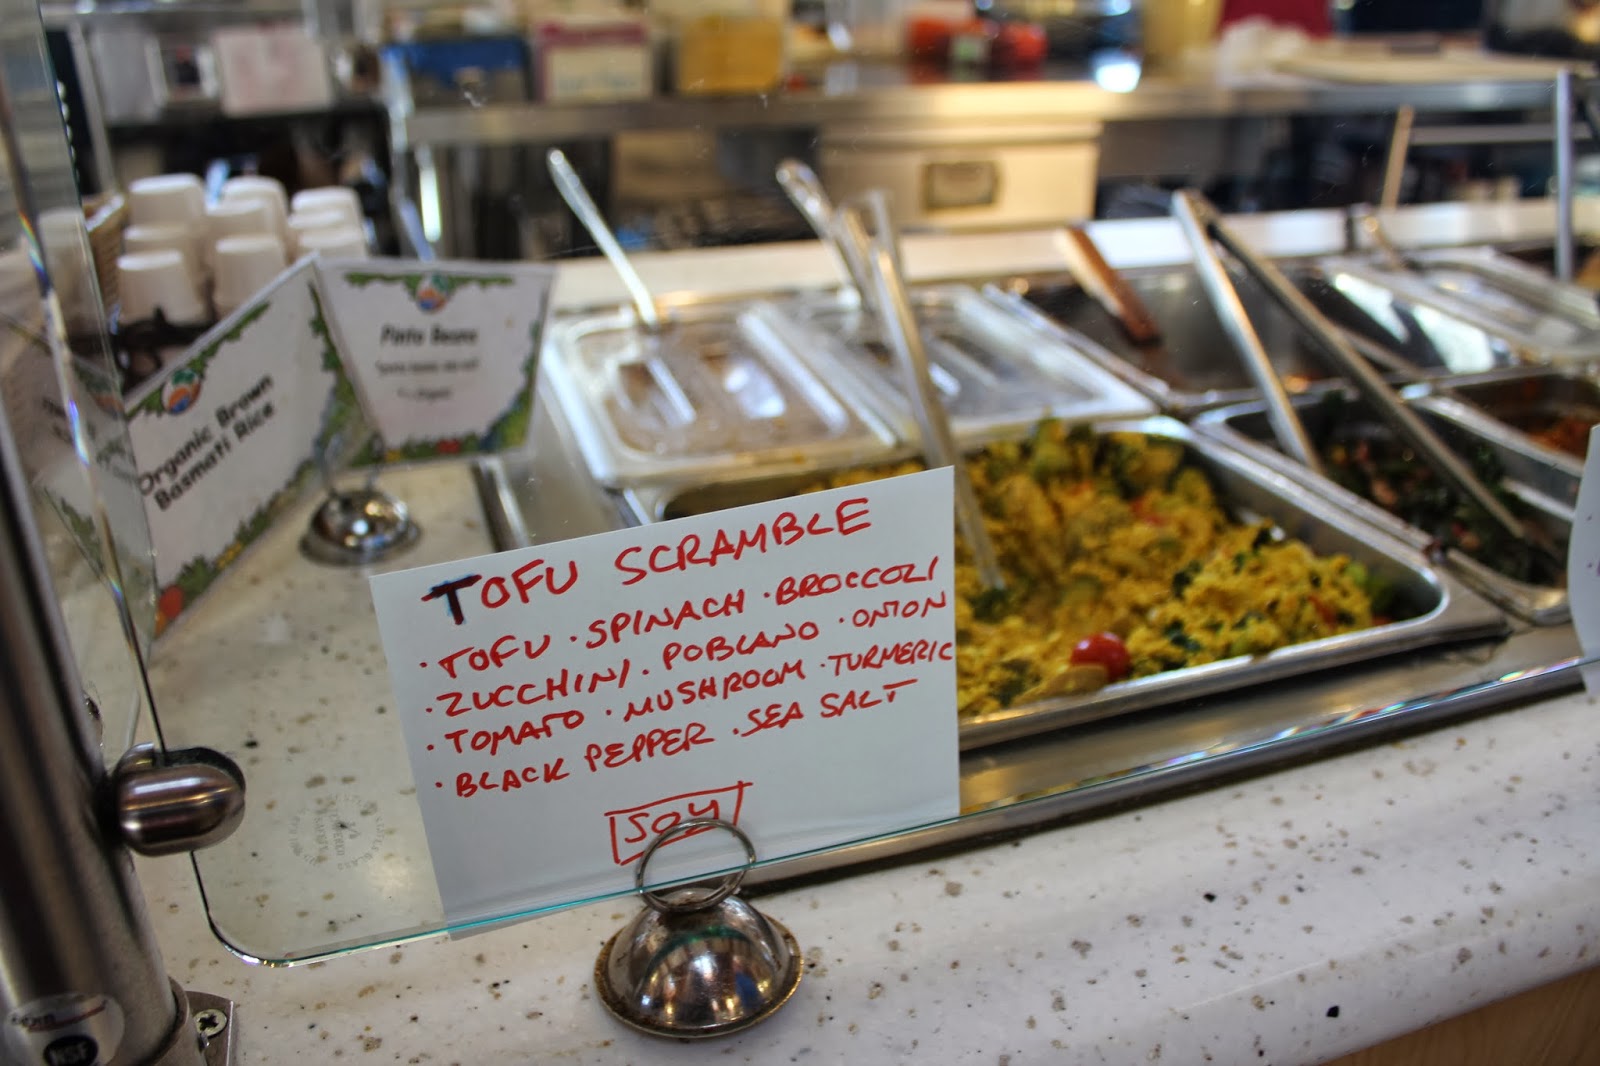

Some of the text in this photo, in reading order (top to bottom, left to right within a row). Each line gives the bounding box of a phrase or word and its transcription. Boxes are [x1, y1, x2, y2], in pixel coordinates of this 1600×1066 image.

[139, 374, 274, 497] Organic Brown
[153, 401, 273, 513] Basmati Rice
[423, 498, 871, 624] TOFU SCRAMBLE
[439, 557, 938, 678] TOFU SPINACH BROCCOLI
[437, 659, 630, 717] ZUCCHINI
[663, 622, 819, 670] POBLANO
[445, 640, 952, 755] TOMATO MUSHROOM TURMERIC
[456, 679, 917, 797] BLACK PEPPER SEA SALT
[625, 799, 721, 842] SOY
